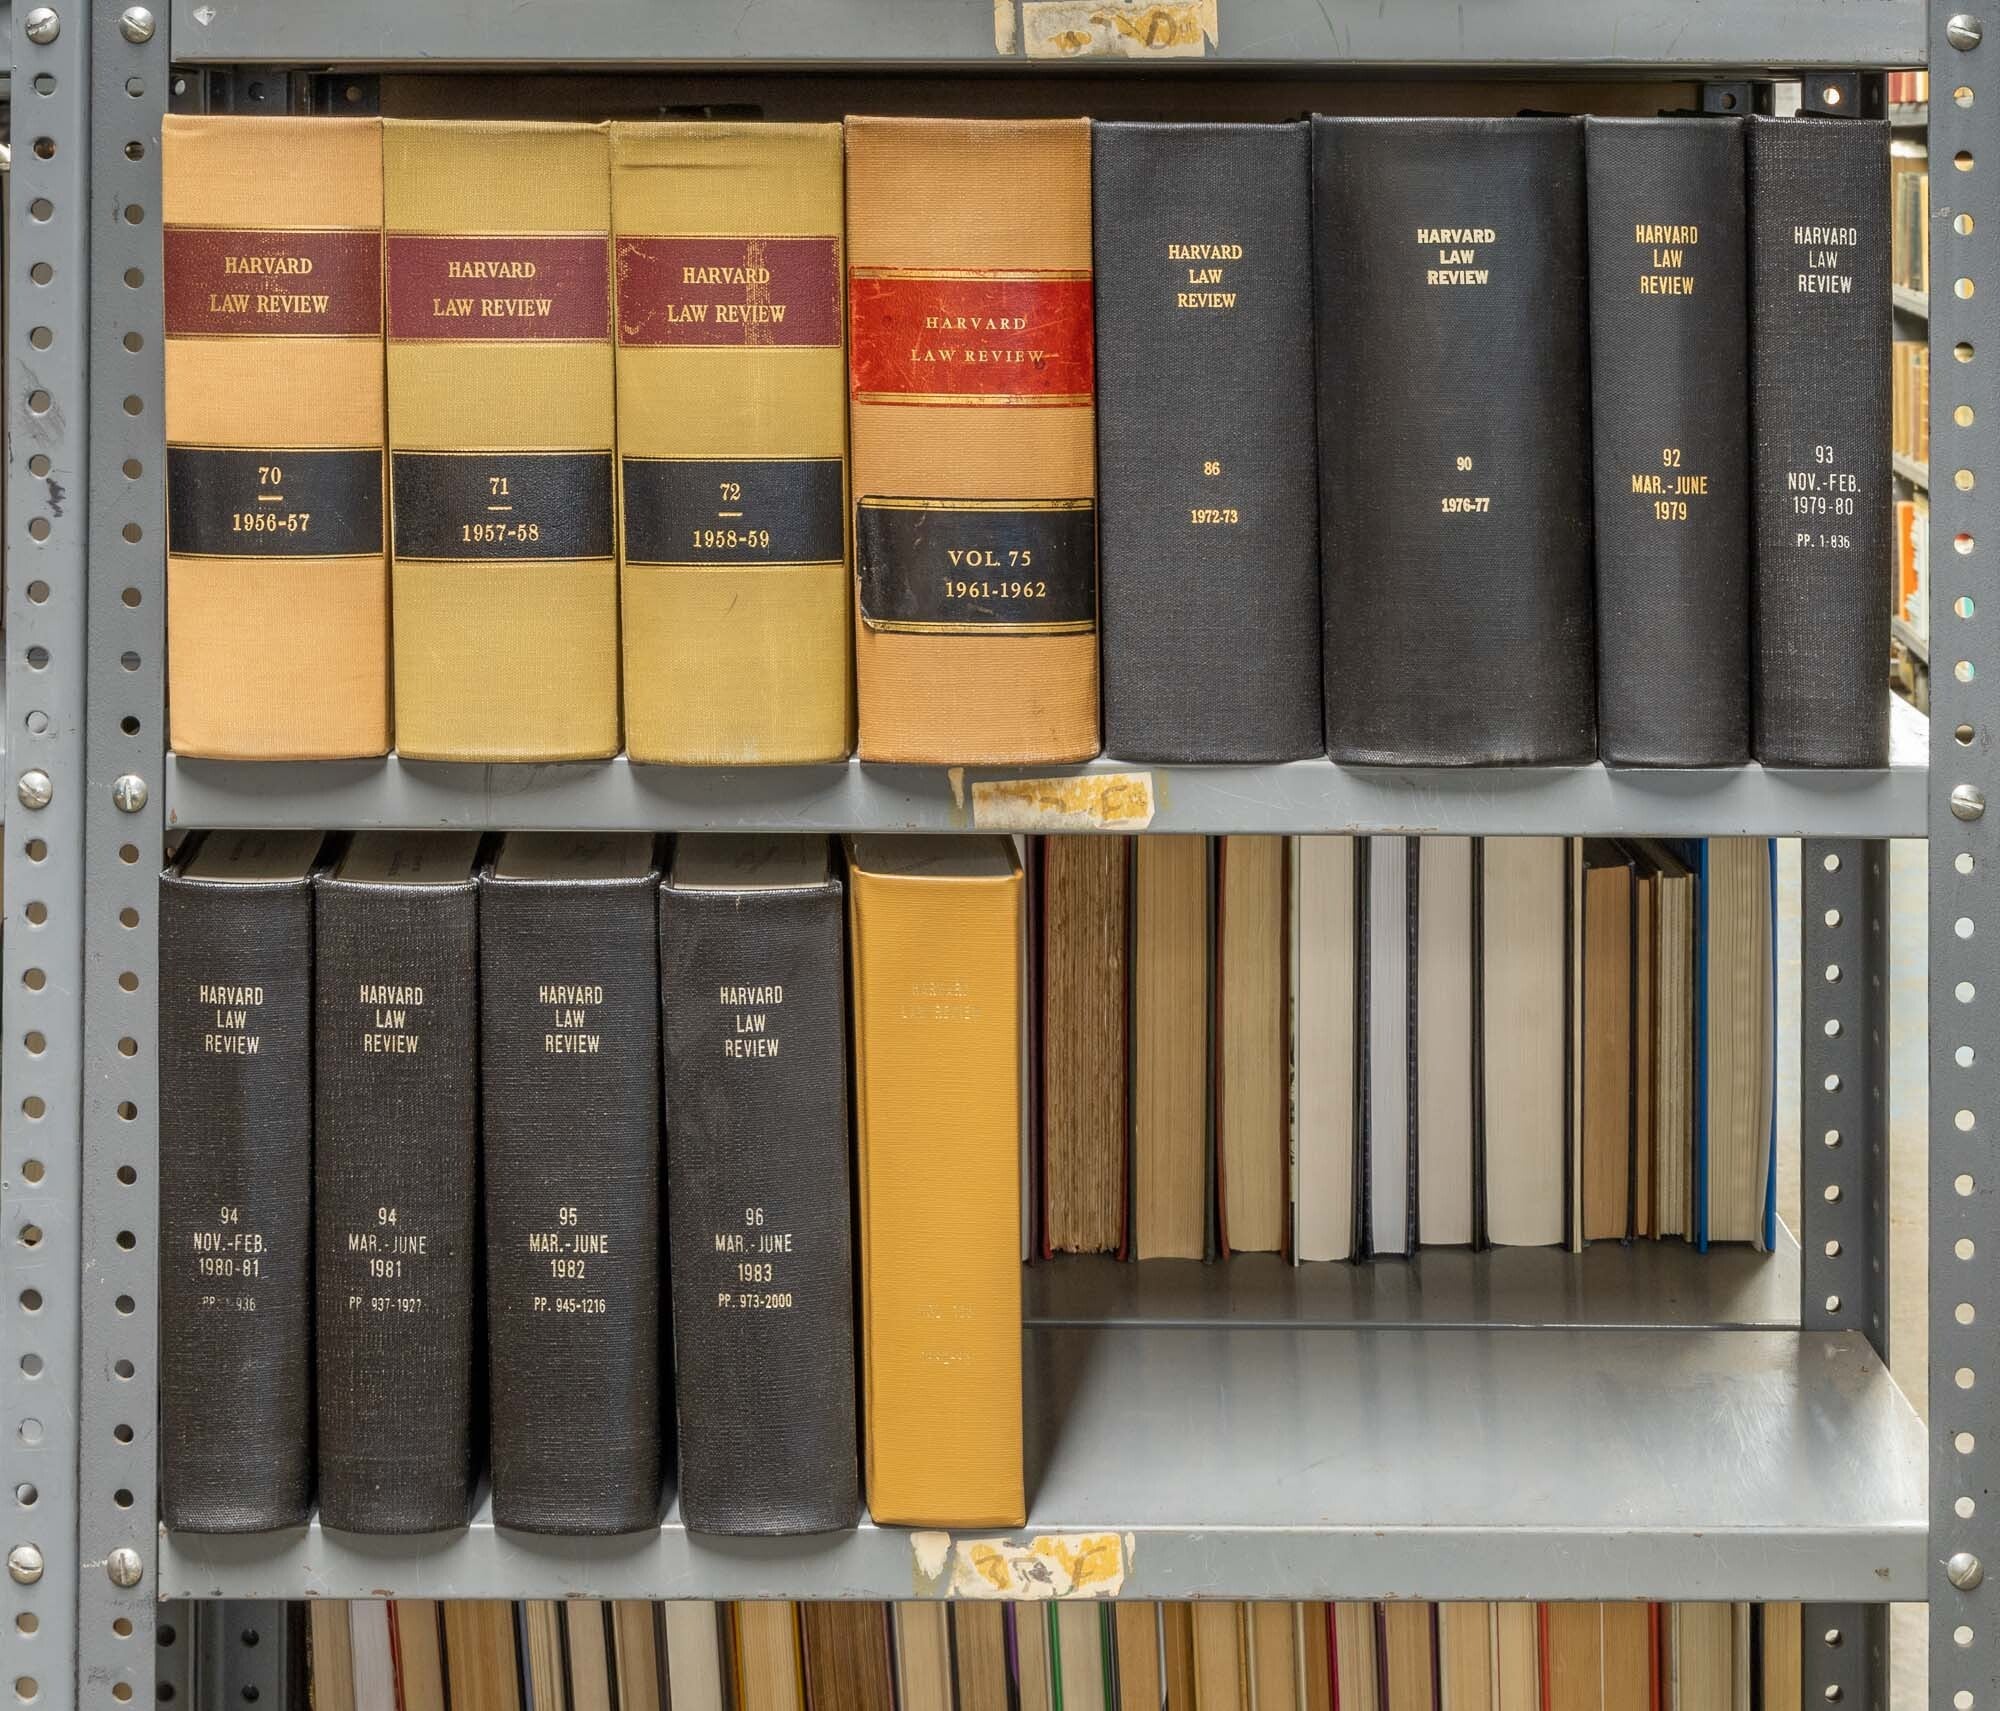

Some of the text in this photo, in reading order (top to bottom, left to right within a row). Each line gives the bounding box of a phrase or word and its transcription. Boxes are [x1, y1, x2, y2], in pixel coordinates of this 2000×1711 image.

[1418, 229, 1495, 243] HARVARD
[1636, 225, 1698, 244] HARVARD
[1795, 227, 1857, 246] HARVARD
[1168, 245, 1242, 260] HARVARD
[1440, 251, 1474, 264] LAW
[1654, 250, 1683, 268] LAW
[1809, 251, 1837, 268] LAW
[225, 257, 312, 275] HARVARD
[448, 262, 536, 279] HARVARD
[683, 268, 770, 284] HARVARD
[1189, 270, 1222, 284] LAW
[1427, 270, 1488, 285] REVIEW
[1799, 275, 1852, 293] REVIEW
[1641, 277, 1694, 295] REVIEW
[210, 295, 329, 313] LAW REVIEW
[434, 299, 552, 317] LAW REVIEW
[1178, 294, 1236, 308] REVIEW
[668, 306, 786, 322] LAW REVIEW
[926, 317, 1026, 330] HARVARD
[911, 349, 1045, 362] LAW REVIEW
[1663, 449, 1680, 467] 92
[1816, 446, 1833, 463] 93
[1204, 462, 1220, 475] 86
[1457, 457, 1472, 471] 90
[259, 467, 281, 484] 70
[1788, 473, 1860, 492] NOV.-FEB.
[489, 478, 508, 495] 71
[720, 484, 741, 501] 72
[1632, 476, 1707, 494] MAR.-JUNE
[1442, 498, 1489, 512] 1976-77
[1654, 502, 1687, 520] 1979
[1795, 497, 1853, 515] 1979-80
[233, 515, 309, 531] 1956-57
[1192, 510, 1238, 523] 1972-73
[462, 525, 539, 541] 1957-58
[694, 530, 769, 547] 1958-59
[1821, 535, 1850, 548] 1-836
[1009, 551, 1031, 566] 75
[945, 582, 1046, 598] 1961-1962
[200, 986, 263, 1005] HARVARD
[361, 986, 423, 1005] HARVARD
[540, 986, 603, 1005] HARVARD
[721, 986, 782, 1004] HARVARD
[217, 1010, 246, 1028] LAW
[376, 1010, 405, 1028] LAW
[556, 1010, 584, 1028] LAW
[737, 1015, 766, 1032] LAW
[206, 1036, 259, 1054] REVIEW
[364, 1035, 418, 1053] REVIEW
[546, 1035, 599, 1053] REVIEW
[725, 1040, 779, 1057] REVIEW
[221, 1207, 238, 1224] 94
[378, 1208, 396, 1225] 94
[559, 1209, 577, 1225] 95
[746, 1209, 763, 1225] 96
[194, 1234, 267, 1252] NOV.-FEB.
[349, 1234, 426, 1254] MAR.-JUNE
[529, 1235, 608, 1253] MAR.-JUNE
[716, 1234, 792, 1252] MAR.-JUNE
[200, 1259, 259, 1276] 1980-81
[370, 1260, 401, 1277] 1981
[551, 1260, 585, 1279] 1982
[738, 1264, 772, 1281] 1983
[556, 1299, 605, 1313] 945-1216
[741, 1293, 791, 1308] 973-2000
